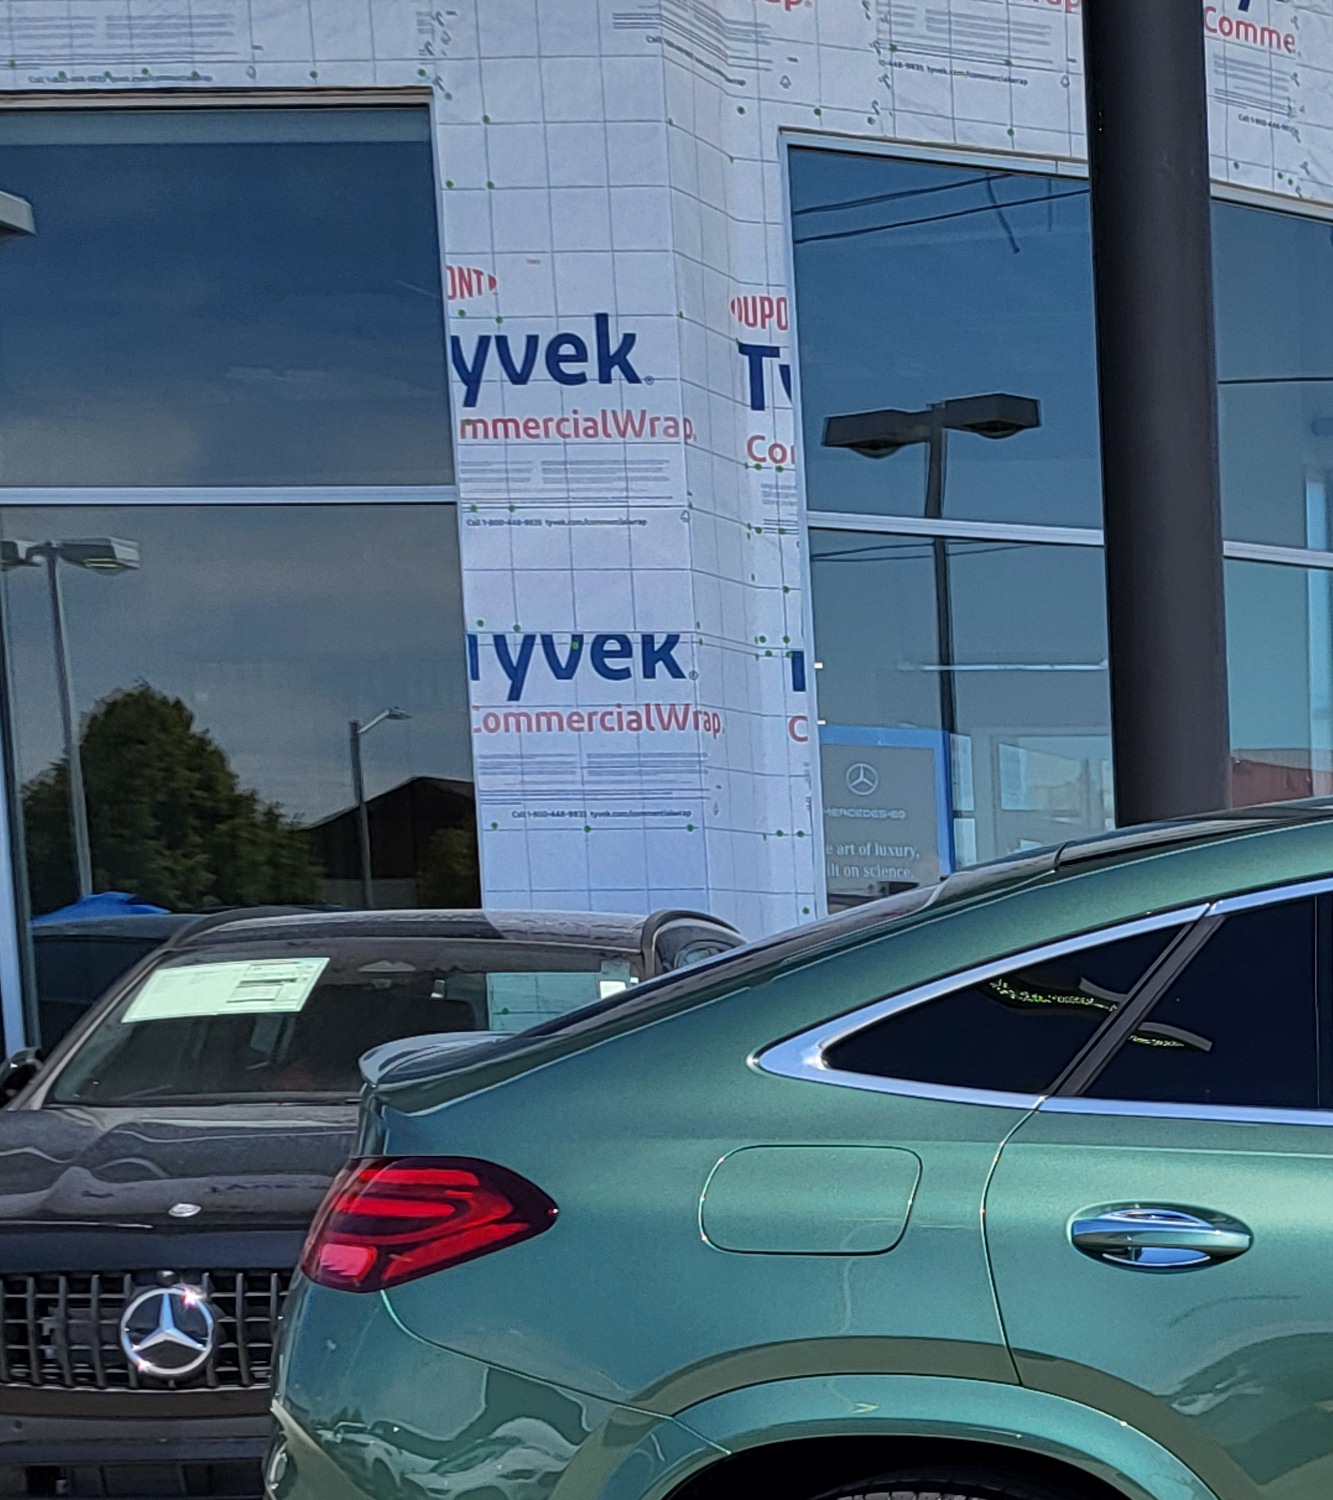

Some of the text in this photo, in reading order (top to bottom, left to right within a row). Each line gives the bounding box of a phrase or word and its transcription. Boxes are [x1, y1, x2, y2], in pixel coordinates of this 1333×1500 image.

[450, 312, 643, 408] yvek
[746, 434, 796, 465] Co
[836, 844, 856, 856] art
[858, 842, 873, 856] of
[875, 842, 920, 862] luxury,
[843, 865, 860, 878] on
